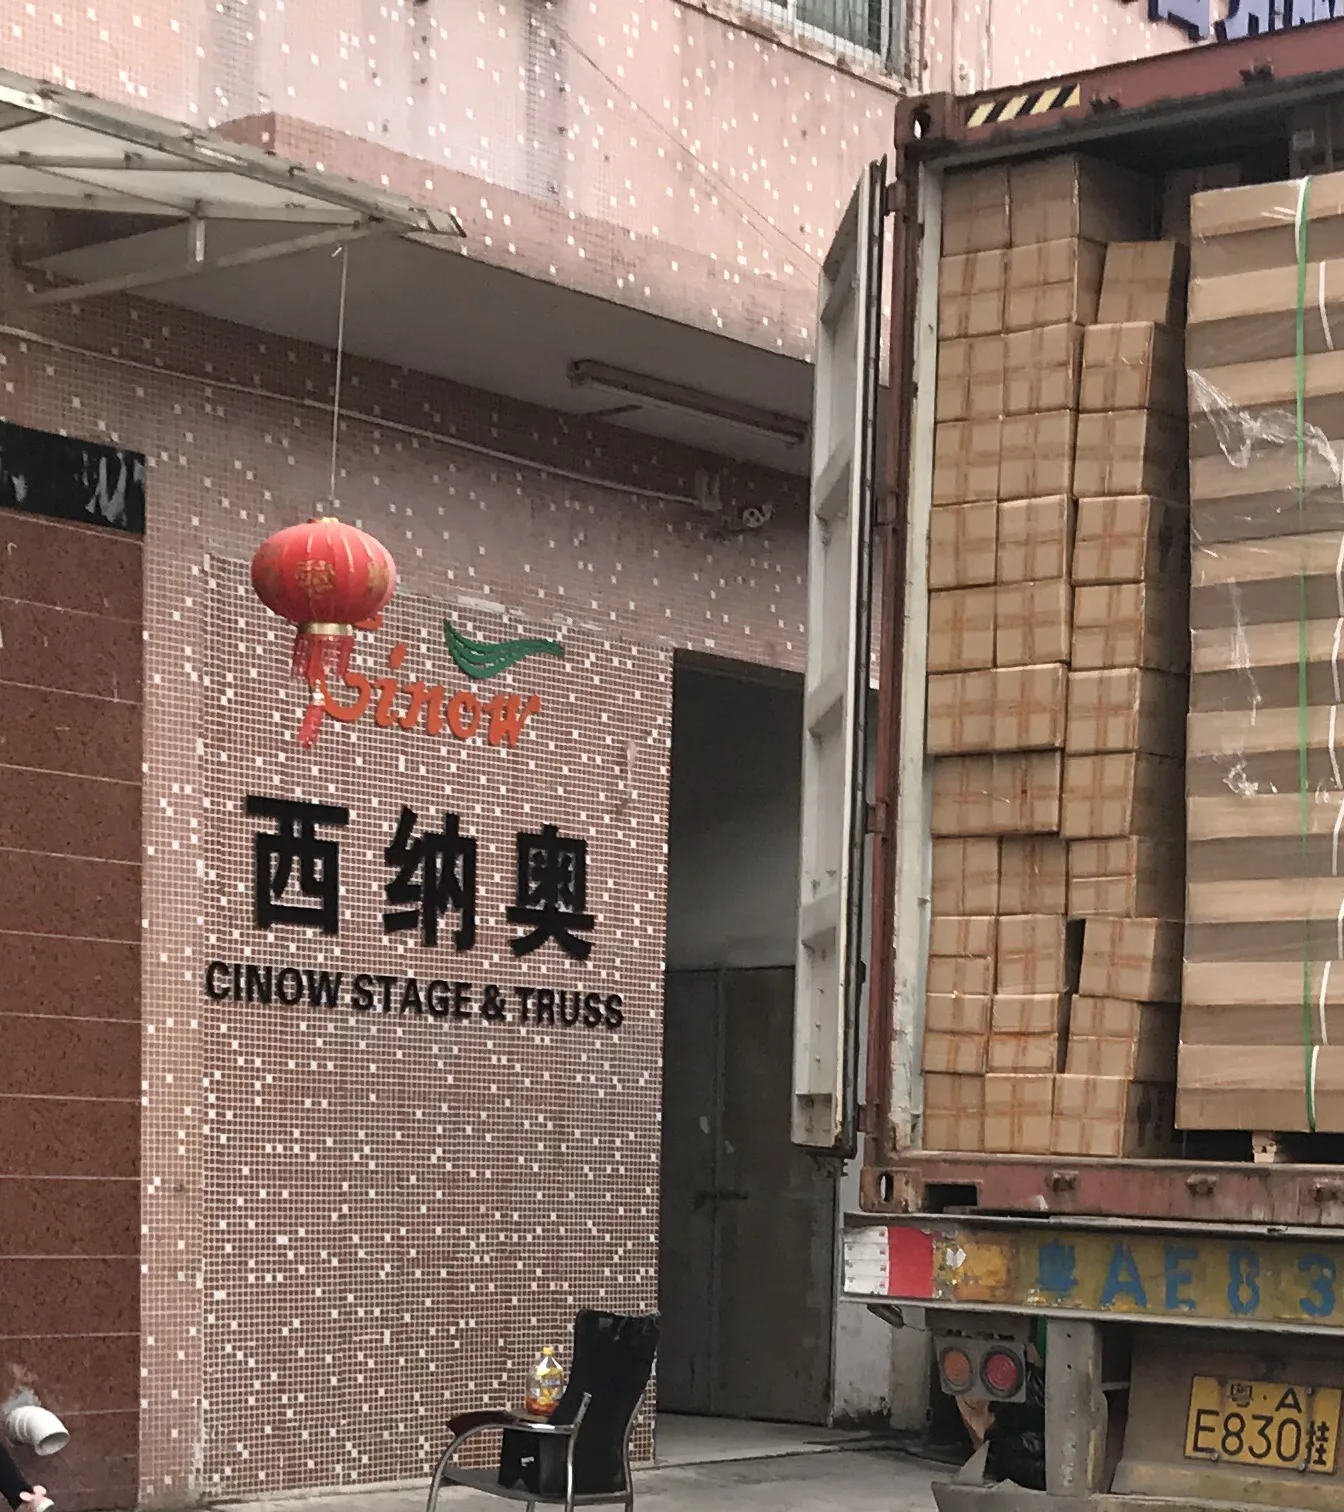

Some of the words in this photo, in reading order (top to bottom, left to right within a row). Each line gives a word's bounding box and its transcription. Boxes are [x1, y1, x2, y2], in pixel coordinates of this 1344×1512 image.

[246, 795, 595, 960] 西纳奥
[205, 961, 343, 1008] CINOW
[354, 973, 472, 1018] STAGE
[481, 984, 507, 1021] &
[514, 985, 625, 1029] TRUSS
[1192, 1408, 1330, 1466] E830挂
